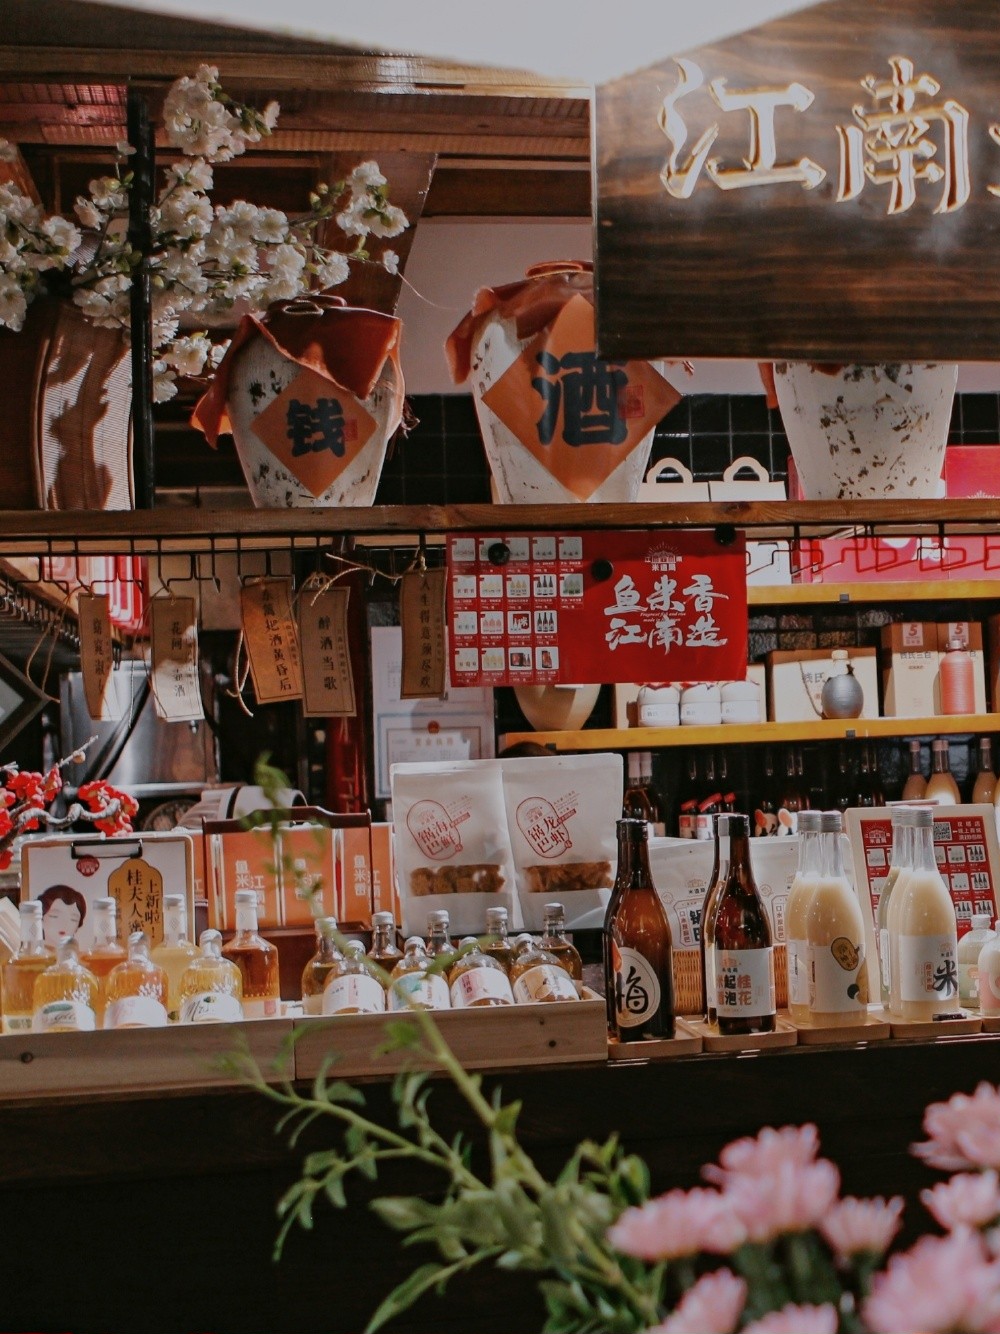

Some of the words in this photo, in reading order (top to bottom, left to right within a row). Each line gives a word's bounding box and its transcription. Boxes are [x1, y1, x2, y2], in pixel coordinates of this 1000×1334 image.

[534, 350, 628, 448] 酒
[284, 398, 346, 458] 钱
[605, 613, 728, 655] 江南造
[932, 959, 958, 997] 米
